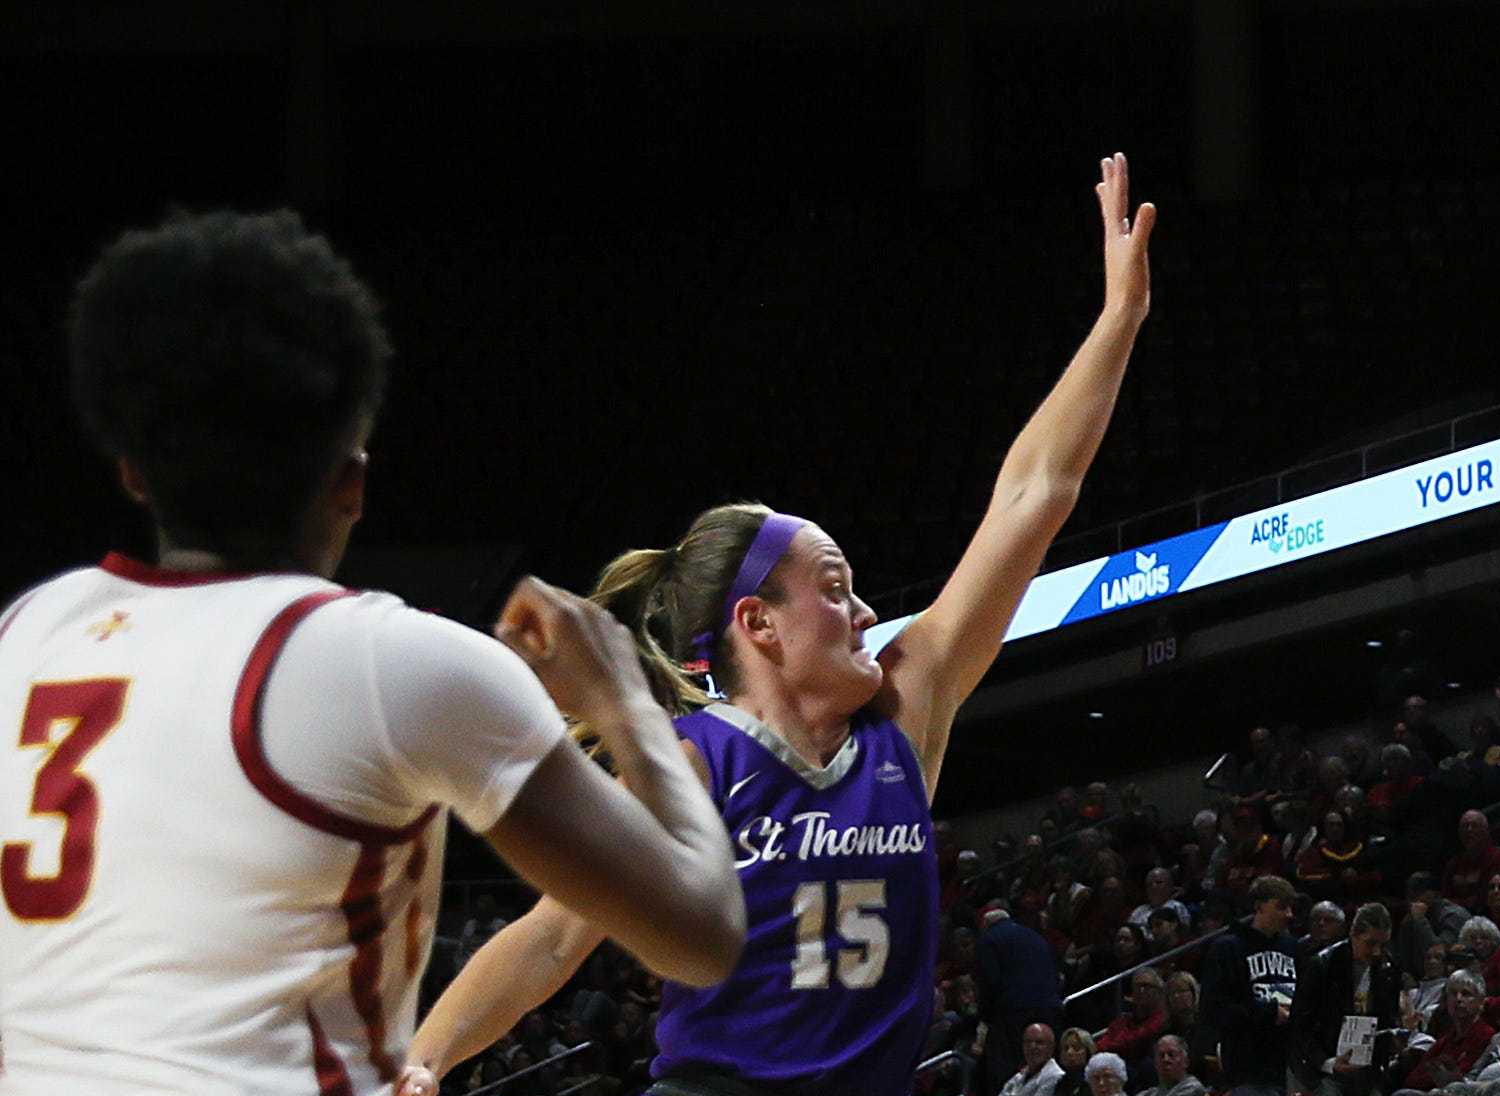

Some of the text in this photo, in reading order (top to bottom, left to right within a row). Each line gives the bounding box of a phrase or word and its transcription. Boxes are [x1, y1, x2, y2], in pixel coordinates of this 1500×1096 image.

[1416, 459, 1493, 507] YOUR
[1287, 520, 1324, 550] EDGE
[1101, 565, 1170, 609] LANDUS
[1147, 637, 1177, 666] 109
[0, 677, 133, 924] 3
[734, 812, 926, 868] St. Thomas
[791, 880, 890, 989] 15
[1247, 951, 1297, 980] IOWA
